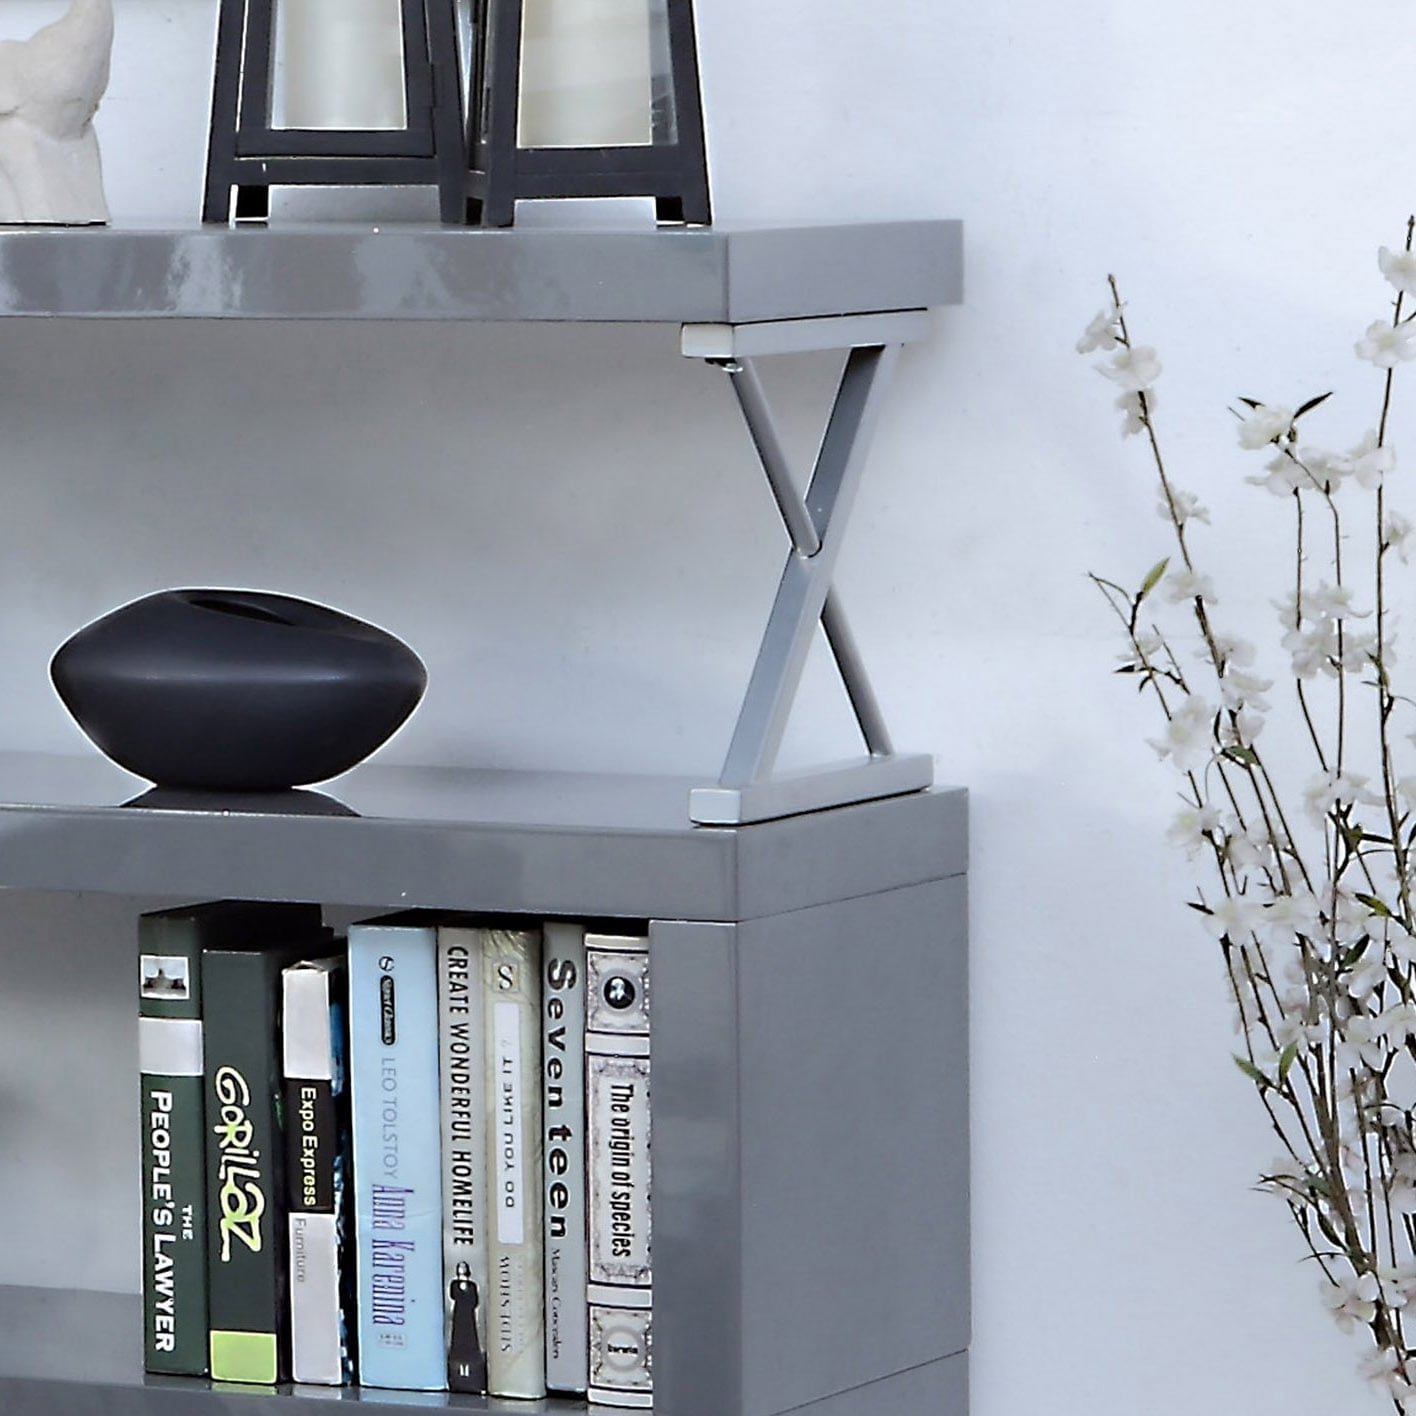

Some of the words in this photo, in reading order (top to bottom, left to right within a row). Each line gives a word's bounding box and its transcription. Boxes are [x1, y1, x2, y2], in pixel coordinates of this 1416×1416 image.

[446, 945, 469, 1019] CREATE
[382, 1056, 398, 1092] LEO
[449, 1022, 472, 1142] WONDERFUL
[502, 1056, 514, 1074] IT
[299, 1087, 317, 1133] Expo
[502, 1083, 514, 1125] LIKE
[611, 1084, 634, 1115] The
[150, 1090, 175, 1229] PEOPLE'S
[382, 1096, 399, 1179] TOLSTOY
[503, 1132, 515, 1171] YOU
[607, 1118, 634, 1171] origin
[299, 1138, 318, 1206] Express
[451, 1150, 474, 1246] HOMELIFE
[504, 1179, 515, 1208] DO
[611, 1175, 634, 1192] of
[182, 1204, 193, 1240] THE
[371, 1183, 415, 1231] Anna
[608, 1195, 633, 1258] species
[295, 1217, 307, 1283] Furniture
[151, 1234, 176, 1353] LAWYER
[371, 1237, 416, 1326] Karenina
